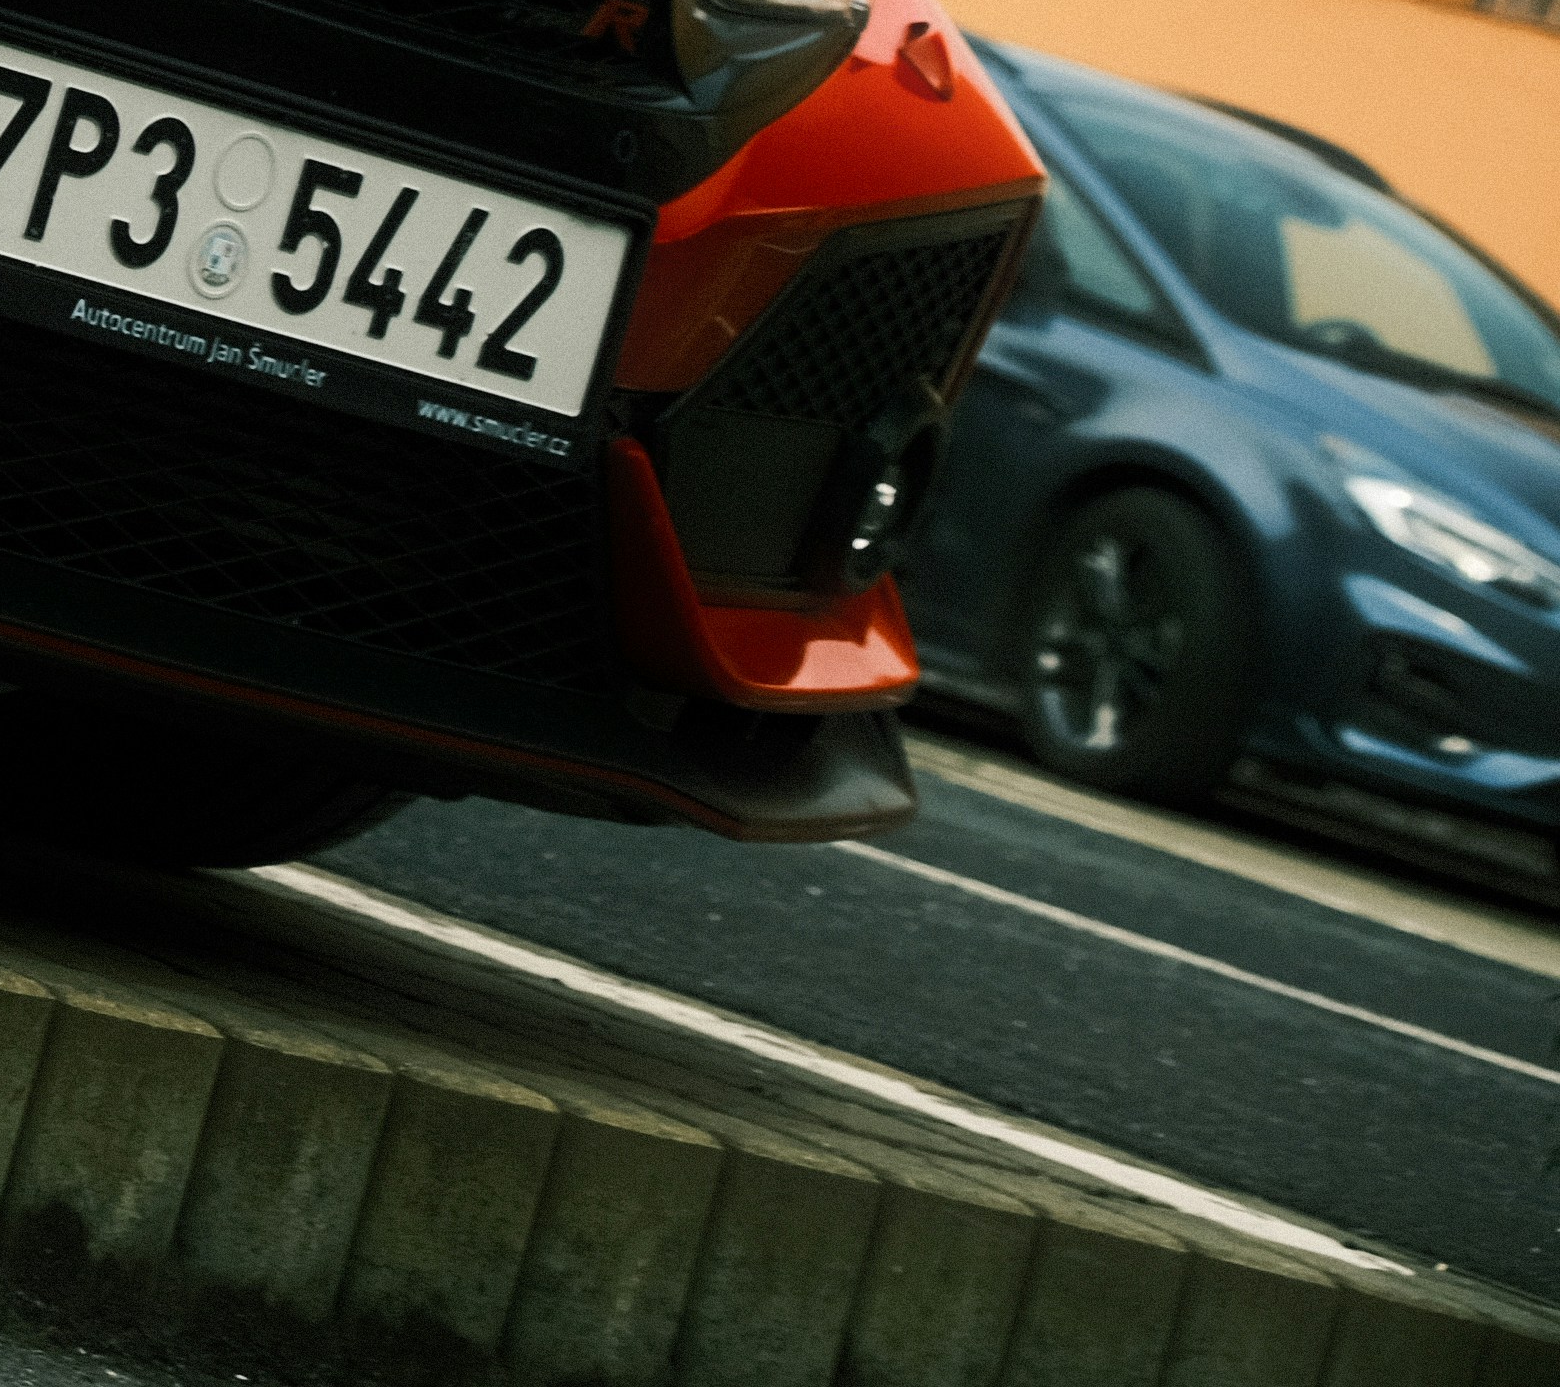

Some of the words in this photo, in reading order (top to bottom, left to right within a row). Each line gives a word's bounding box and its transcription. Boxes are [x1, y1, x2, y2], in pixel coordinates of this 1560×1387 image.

[70, 298, 206, 356] Autocentrum
[207, 337, 243, 365] Jan
[268, 158, 566, 382] 5442
